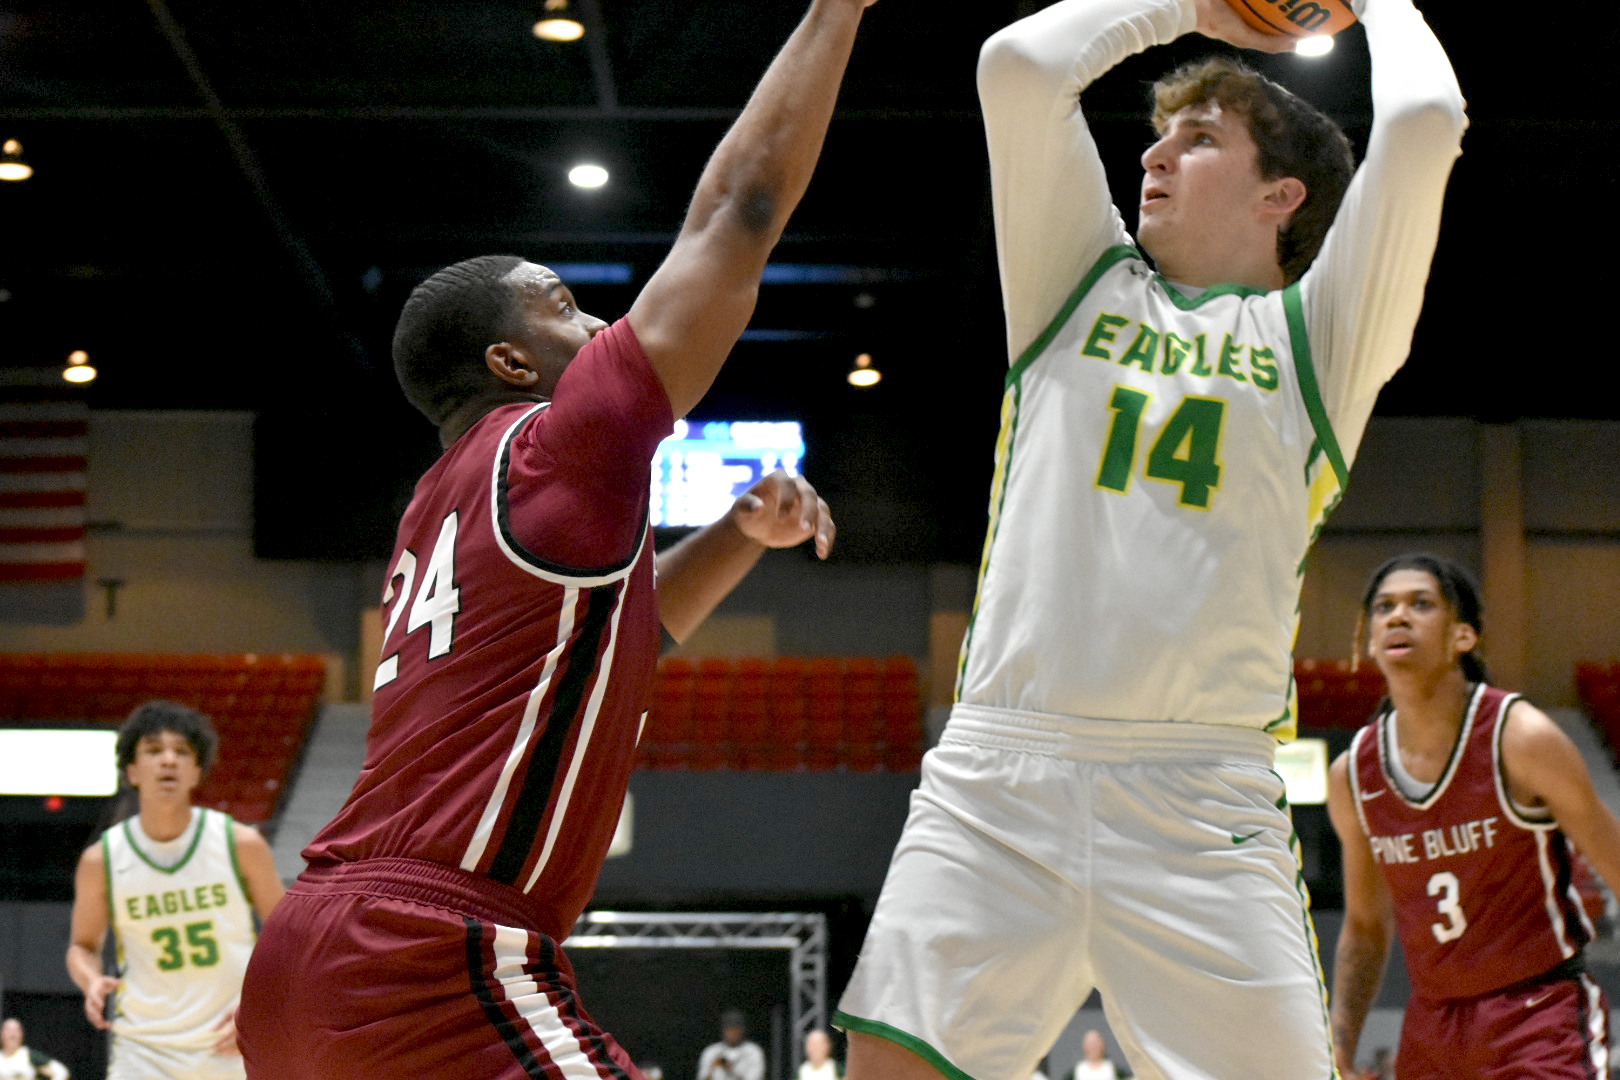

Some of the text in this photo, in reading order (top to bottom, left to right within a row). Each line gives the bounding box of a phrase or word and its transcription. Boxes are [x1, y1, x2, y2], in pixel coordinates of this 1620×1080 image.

[1081, 313, 1279, 392] EAGLES
[1093, 384, 1229, 511] 14
[373, 507, 462, 692] 24
[1370, 816, 1498, 864] PINE BLUFF
[126, 883, 228, 920] EAGLES
[1427, 871, 1468, 944] 3
[151, 919, 220, 972] 35
